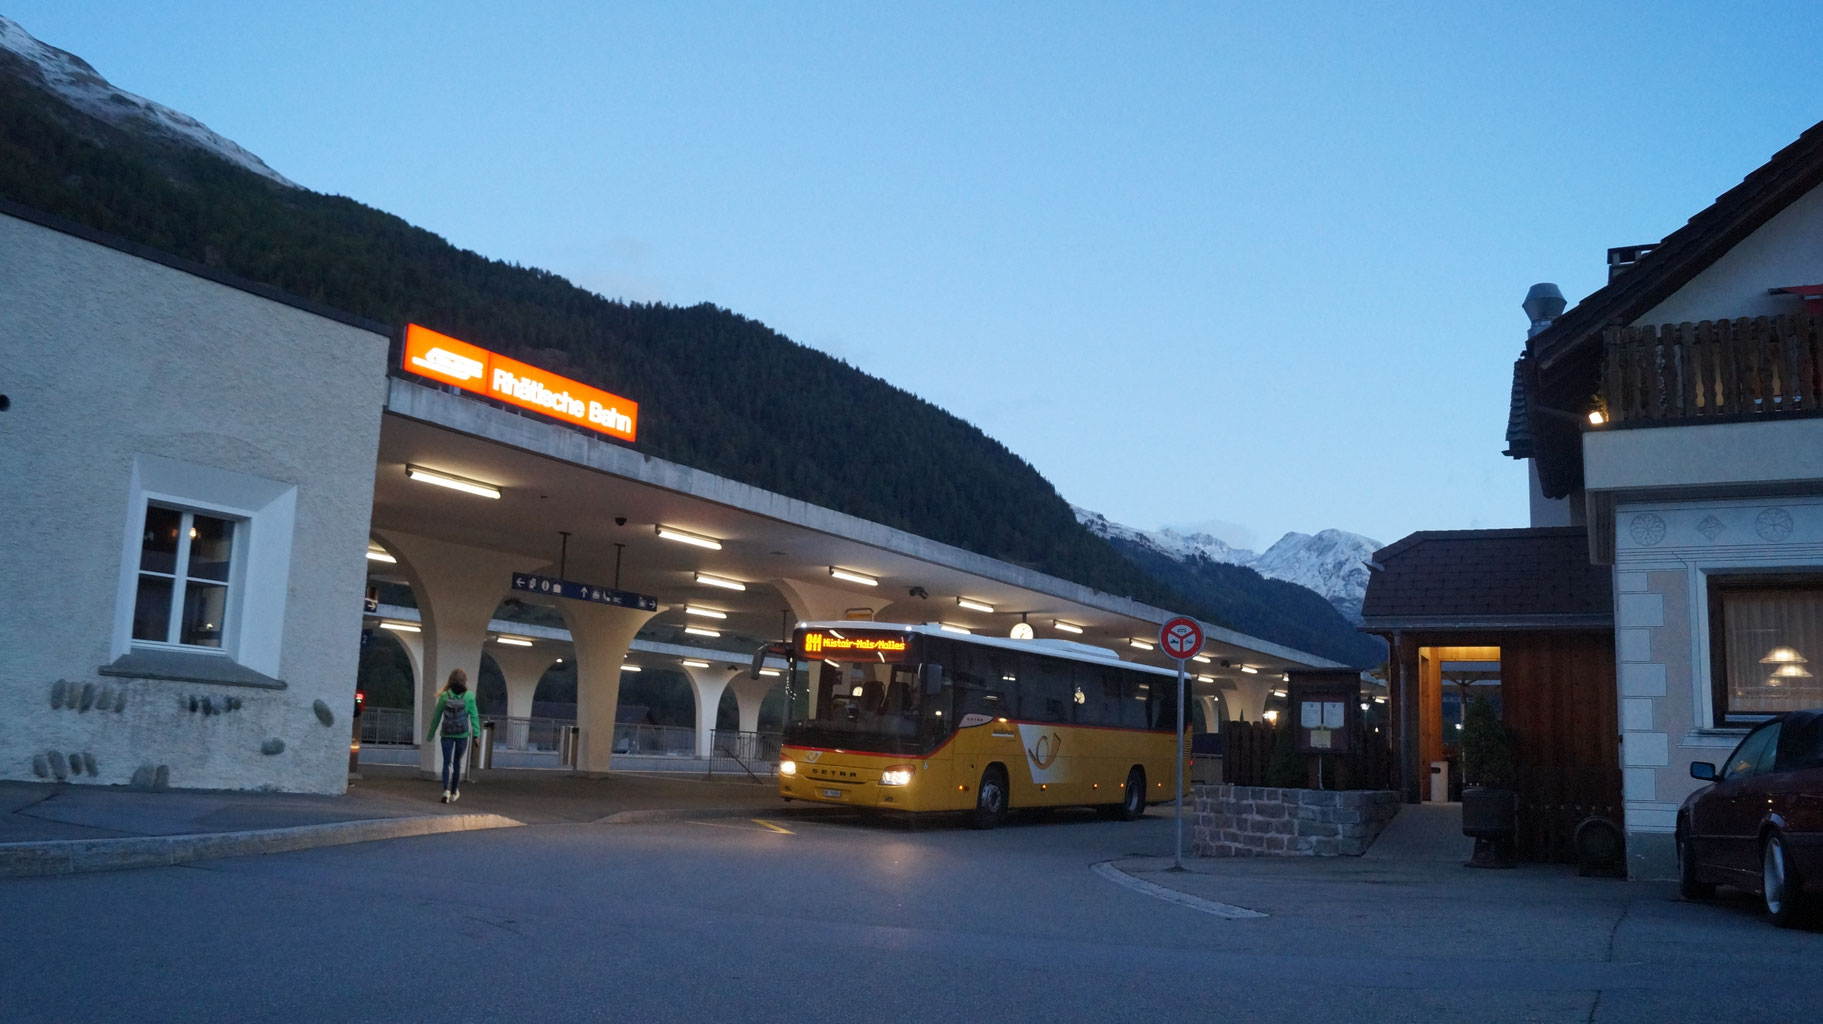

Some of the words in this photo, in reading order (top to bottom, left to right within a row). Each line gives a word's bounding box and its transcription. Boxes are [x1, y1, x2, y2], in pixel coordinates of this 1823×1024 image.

[492, 367, 586, 419] Rhätische
[588, 400, 632, 434] Bahn
[812, 768, 857, 777] SETRA
